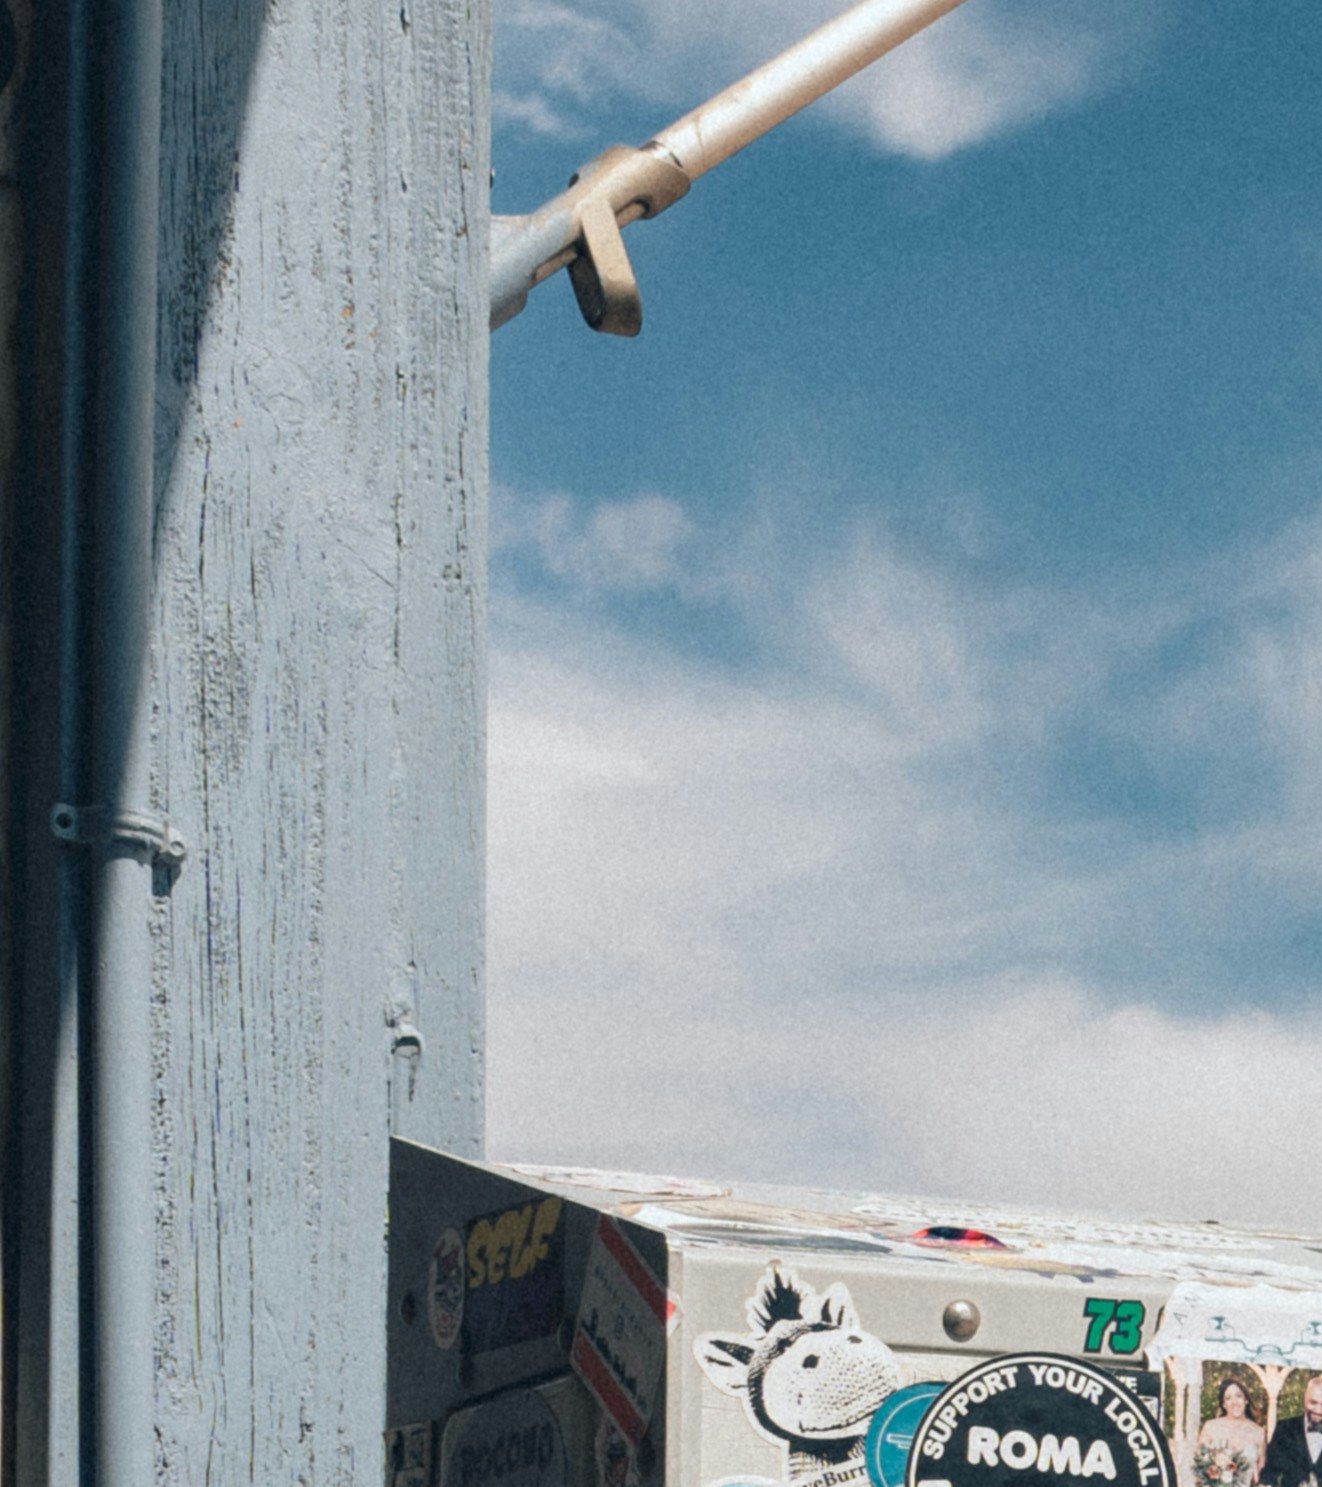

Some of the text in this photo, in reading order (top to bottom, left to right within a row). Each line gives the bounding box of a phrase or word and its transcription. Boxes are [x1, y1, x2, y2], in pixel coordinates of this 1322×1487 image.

[1083, 1297, 1146, 1354] 73
[923, 1364, 1161, 1486] SUPPORT YOUR LOCAL
[967, 1426, 1118, 1480] ROMA
